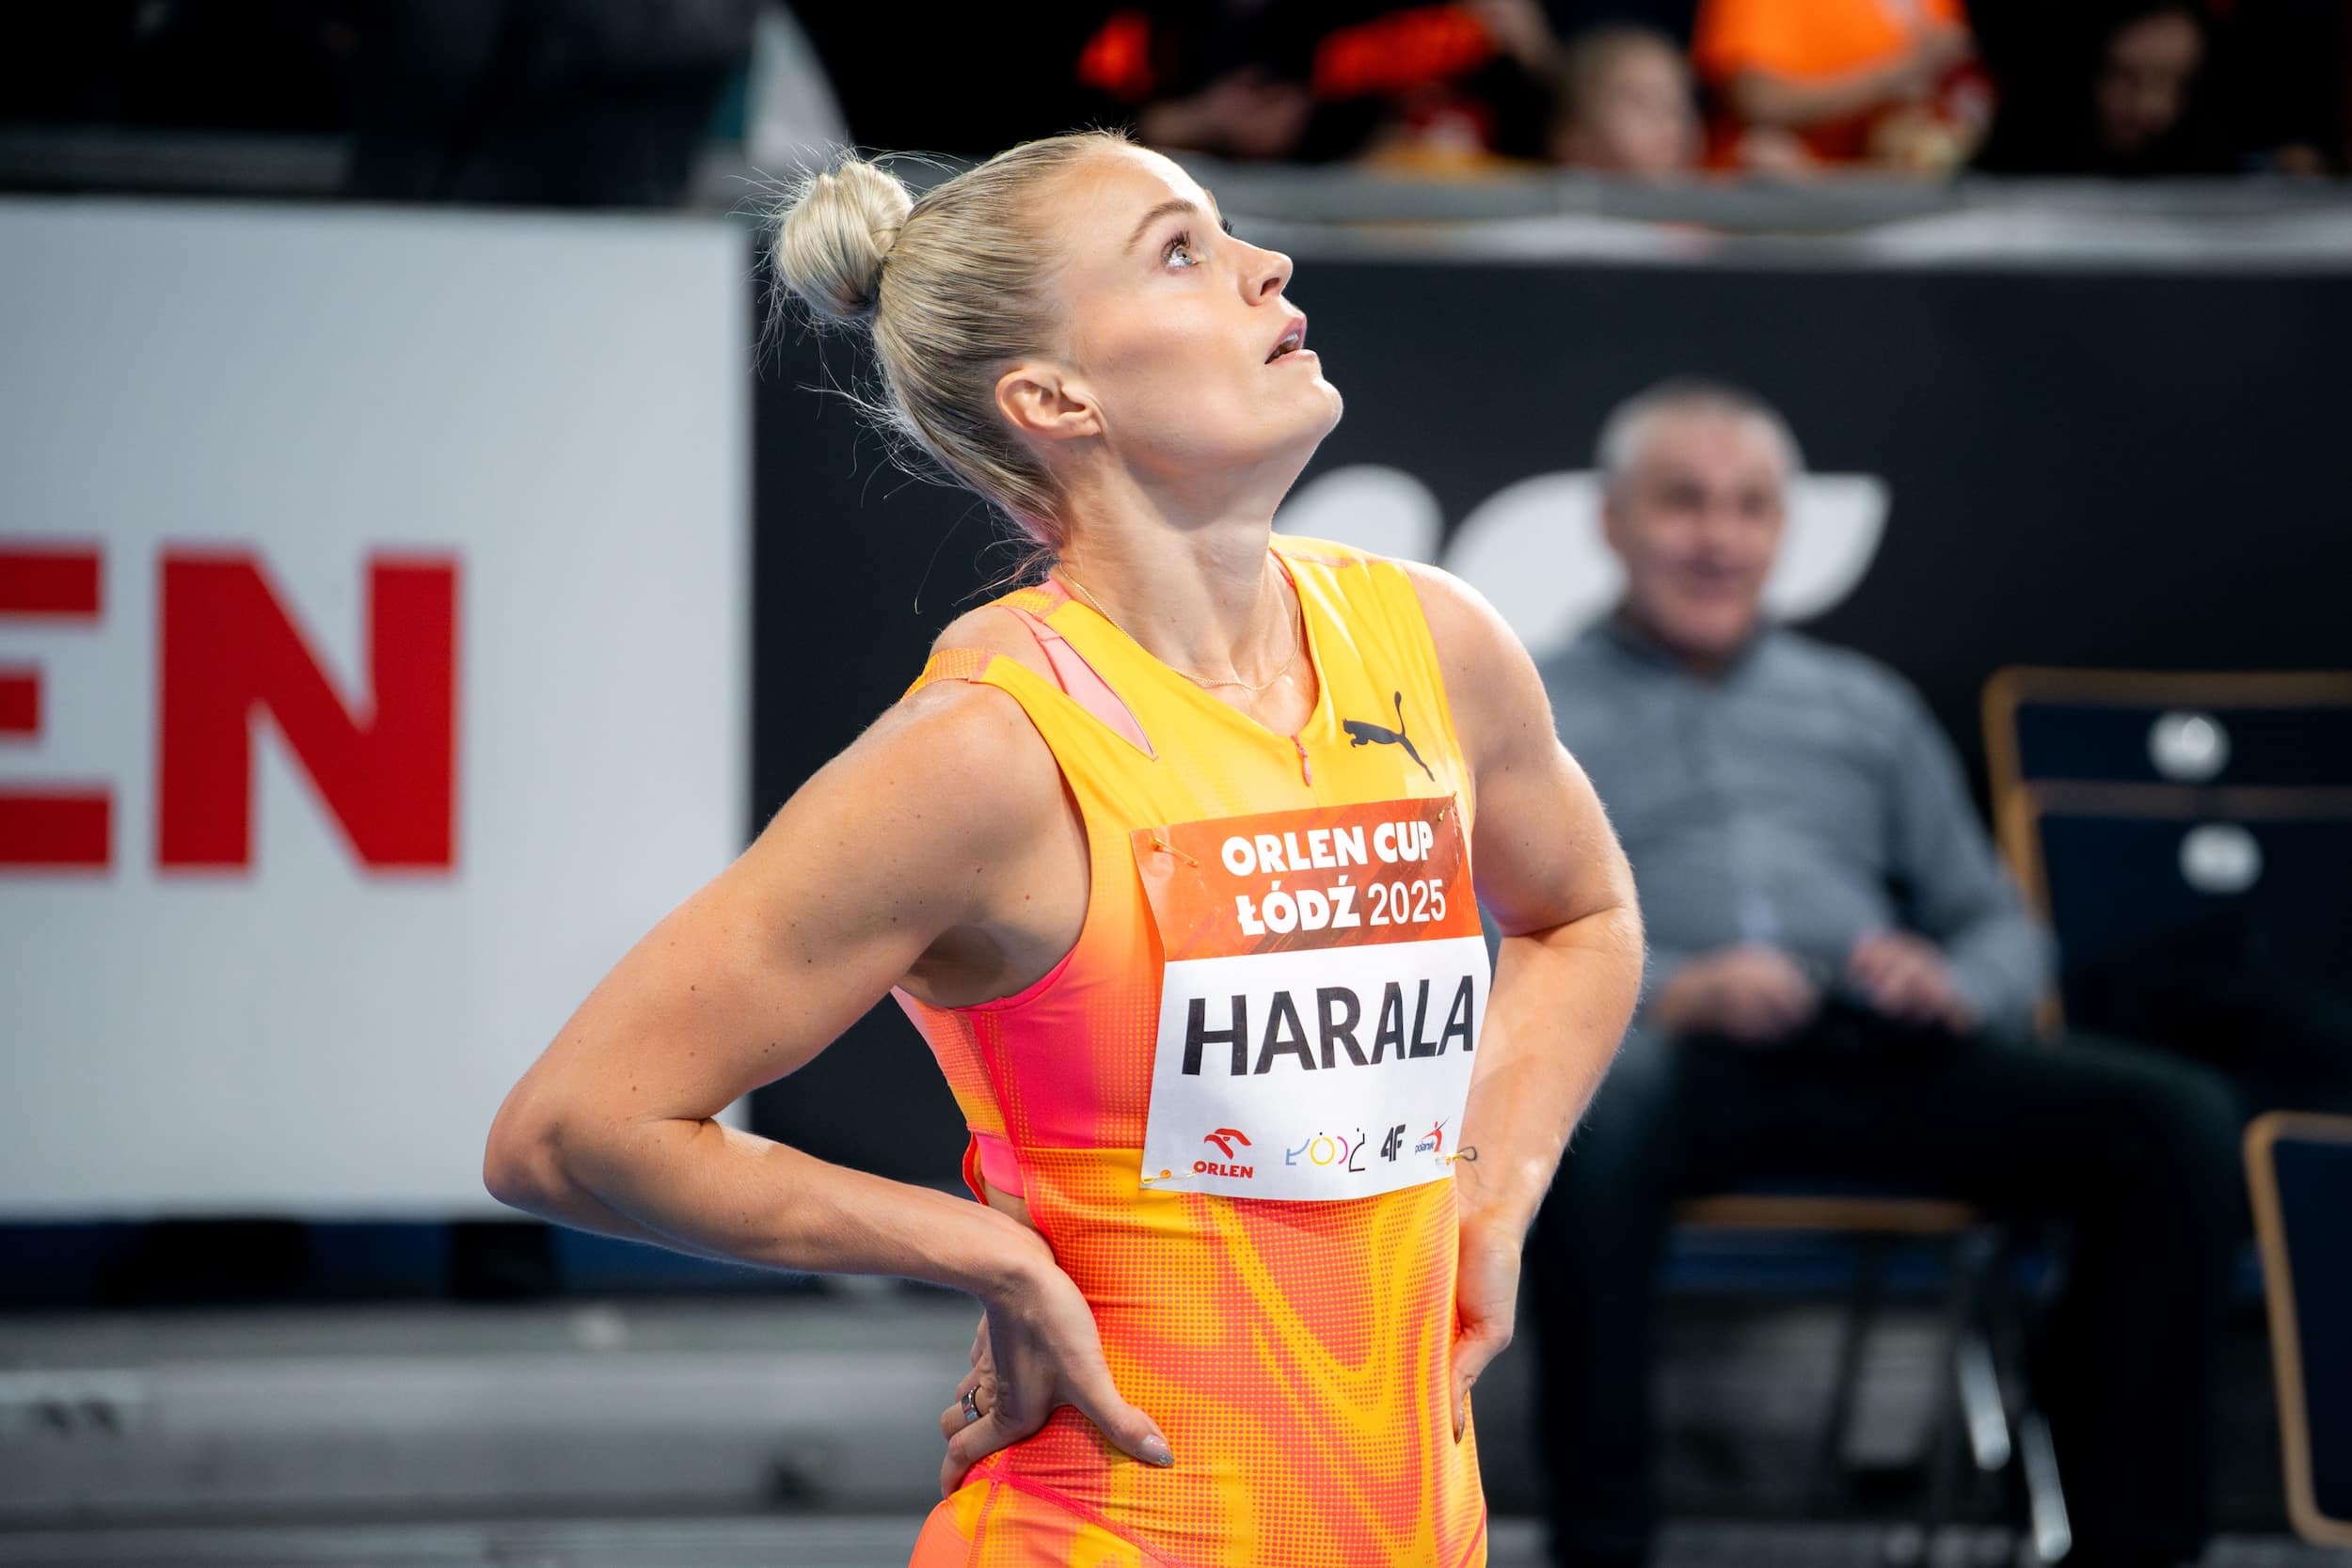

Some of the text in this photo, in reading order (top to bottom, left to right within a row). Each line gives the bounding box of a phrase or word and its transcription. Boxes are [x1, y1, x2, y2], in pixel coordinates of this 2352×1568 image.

[1221, 820, 1434, 877] ORLEN CUP
[1234, 875, 1446, 936] ŁÓDŹ 2025
[1181, 974, 1473, 1077] HARALA
[1193, 1160, 1253, 1179] ORLEN
